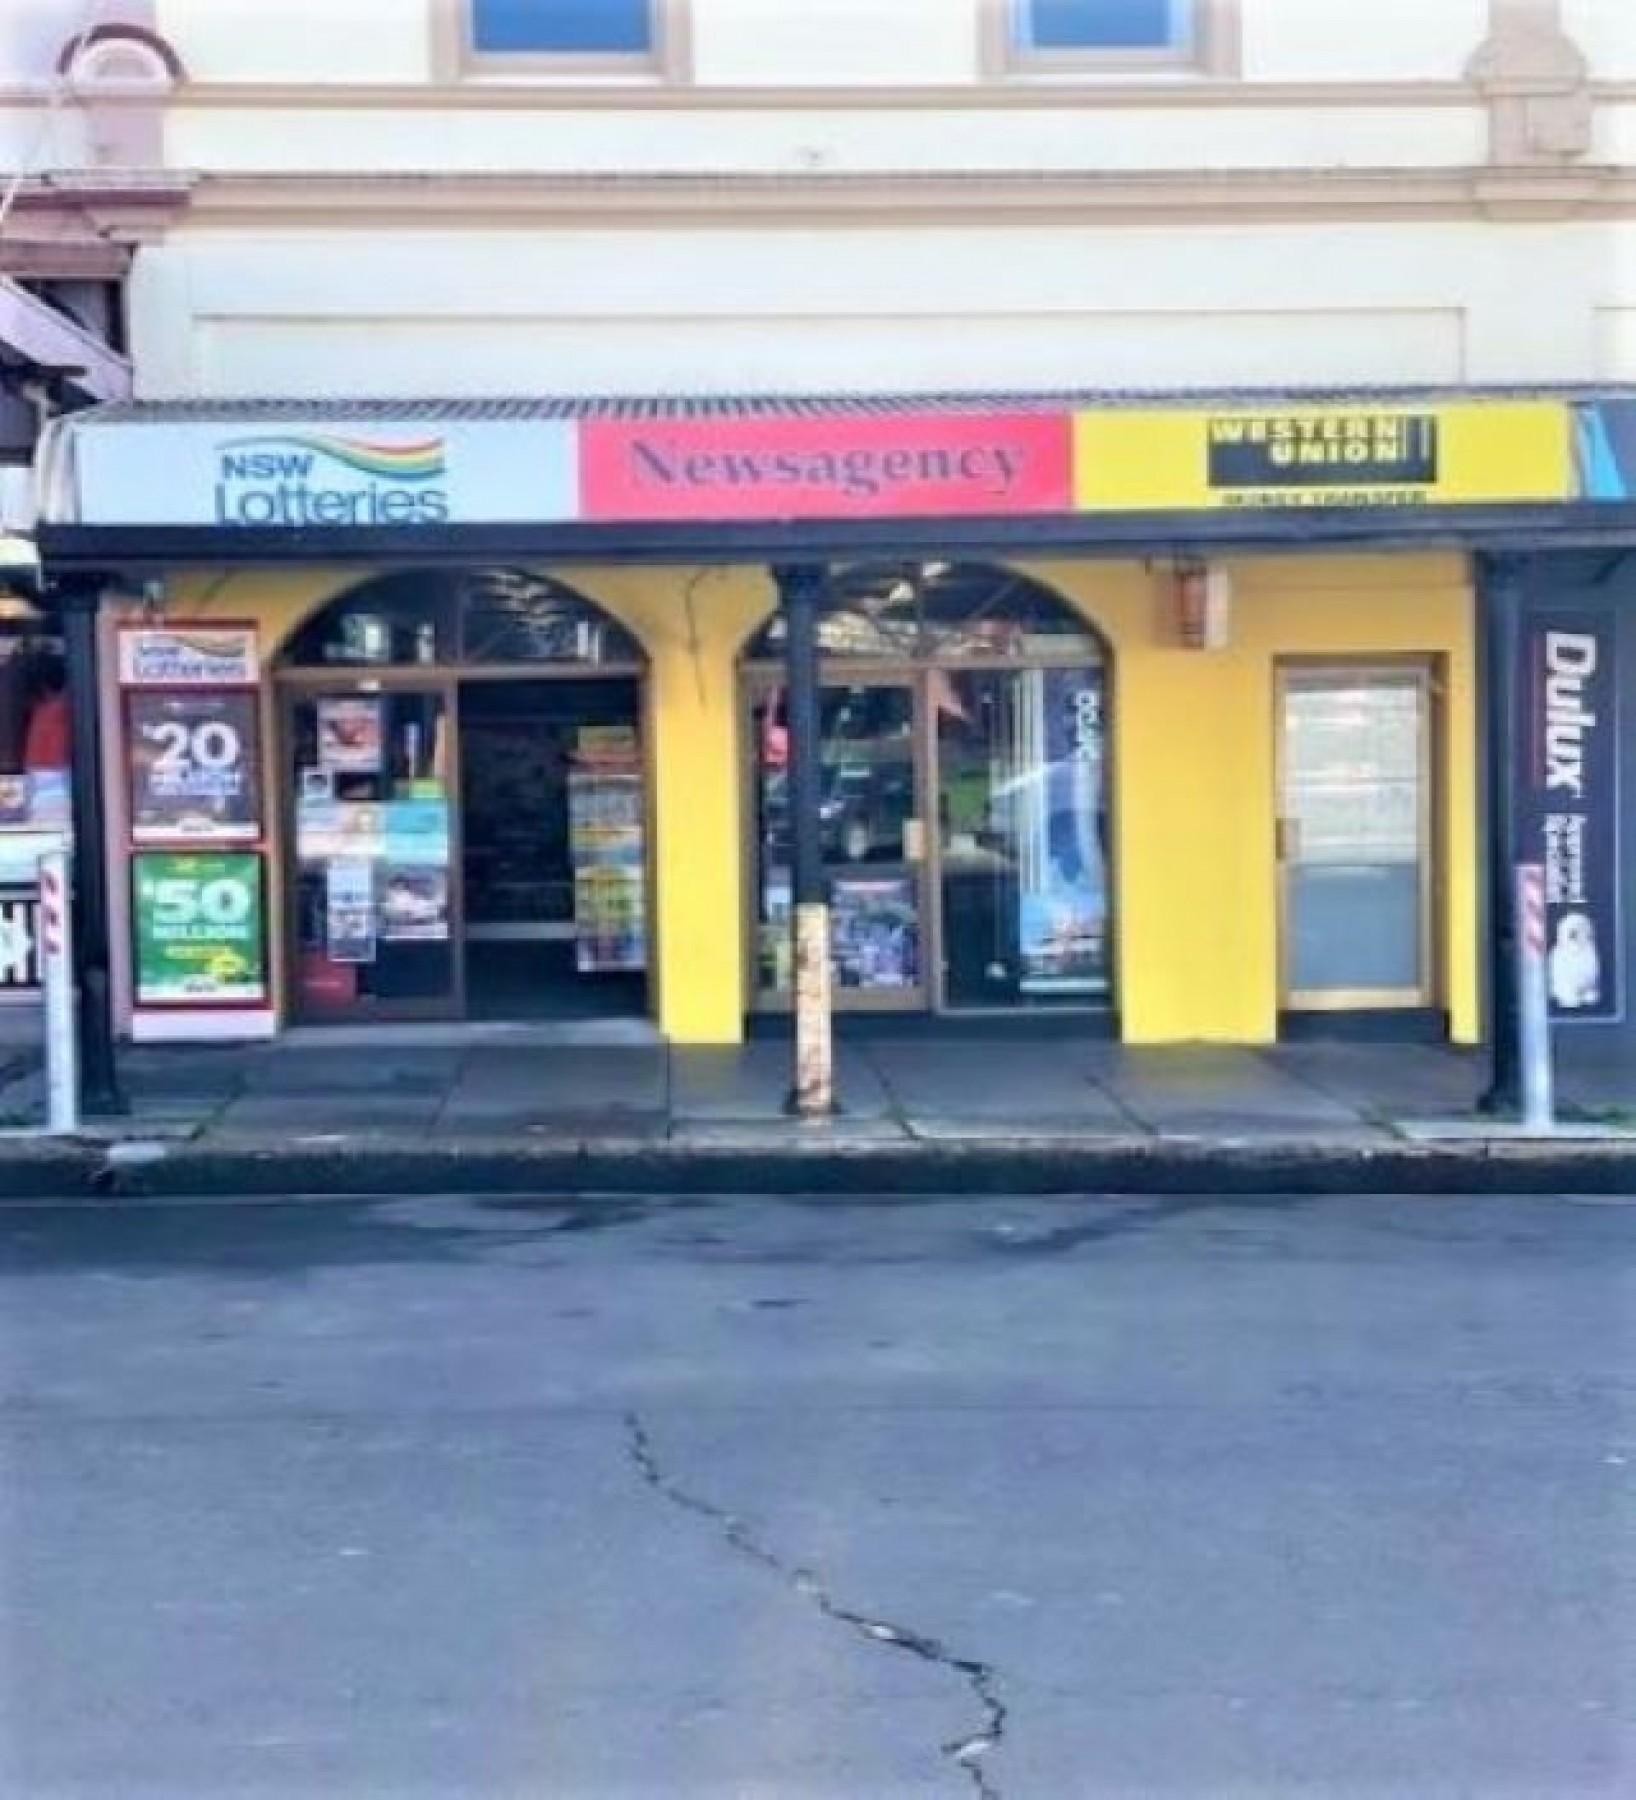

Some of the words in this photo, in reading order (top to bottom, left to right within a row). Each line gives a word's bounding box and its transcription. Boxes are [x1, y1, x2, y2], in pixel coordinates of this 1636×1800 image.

[1210, 417, 1400, 441] WESTERN
[221, 454, 313, 479] NSW
[631, 438, 1022, 496] Newsagency
[1270, 441, 1400, 465] UNION
[214, 483, 449, 525] Lotteries
[1545, 631, 1597, 791] Dulux
